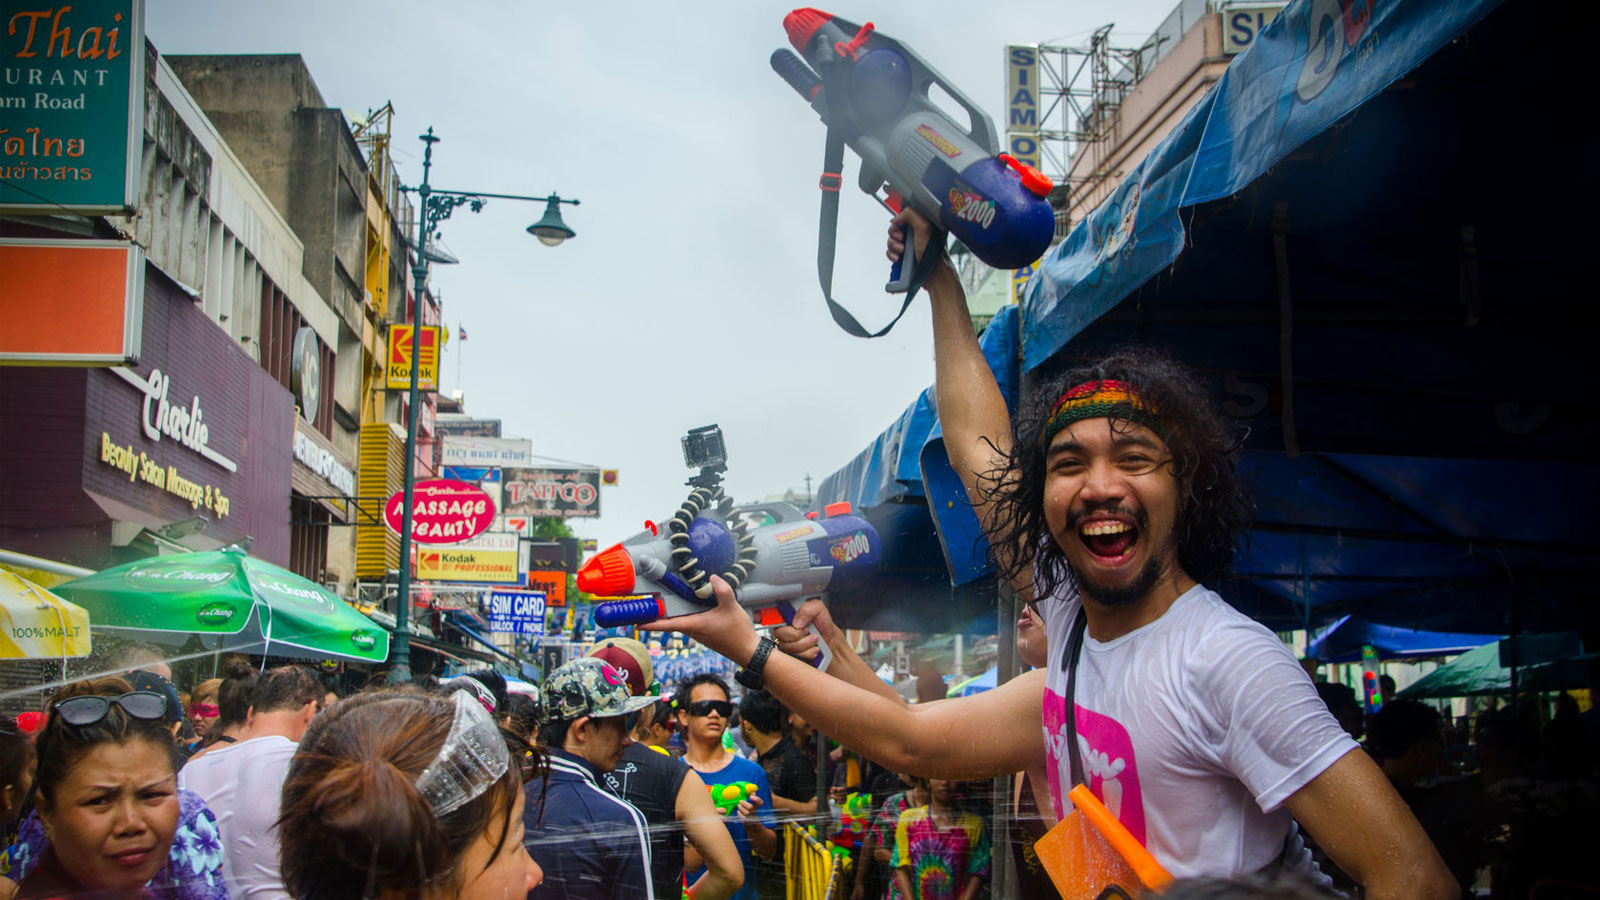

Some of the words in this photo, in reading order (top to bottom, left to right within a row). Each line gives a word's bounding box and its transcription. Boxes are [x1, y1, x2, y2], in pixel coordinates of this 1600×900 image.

[8, 5, 123, 61] Thai
[6, 68, 109, 86] URANT
[1010, 49, 1037, 127] SIAM
[34, 92, 86, 110] Road
[0, 127, 85, 158] ัดไทย
[957, 196, 996, 230] 2000
[391, 366, 433, 378] Kok
[143, 369, 236, 472] Charlie
[102, 432, 139, 482] Beauty
[140, 452, 166, 489] Salon
[166, 466, 204, 510] Massage
[204, 485, 213, 510] &
[214, 488, 229, 519] Spa
[505, 481, 597, 506] TATTOO
[441, 554, 476, 563] Kodak
[844, 534, 869, 562] 2000
[455, 564, 513, 573] PROFESSIONAL
[492, 595, 511, 614] SIM
[514, 596, 545, 616] CARD
[491, 621, 514, 631] UNLOCK
[523, 622, 543, 632] PHONE
